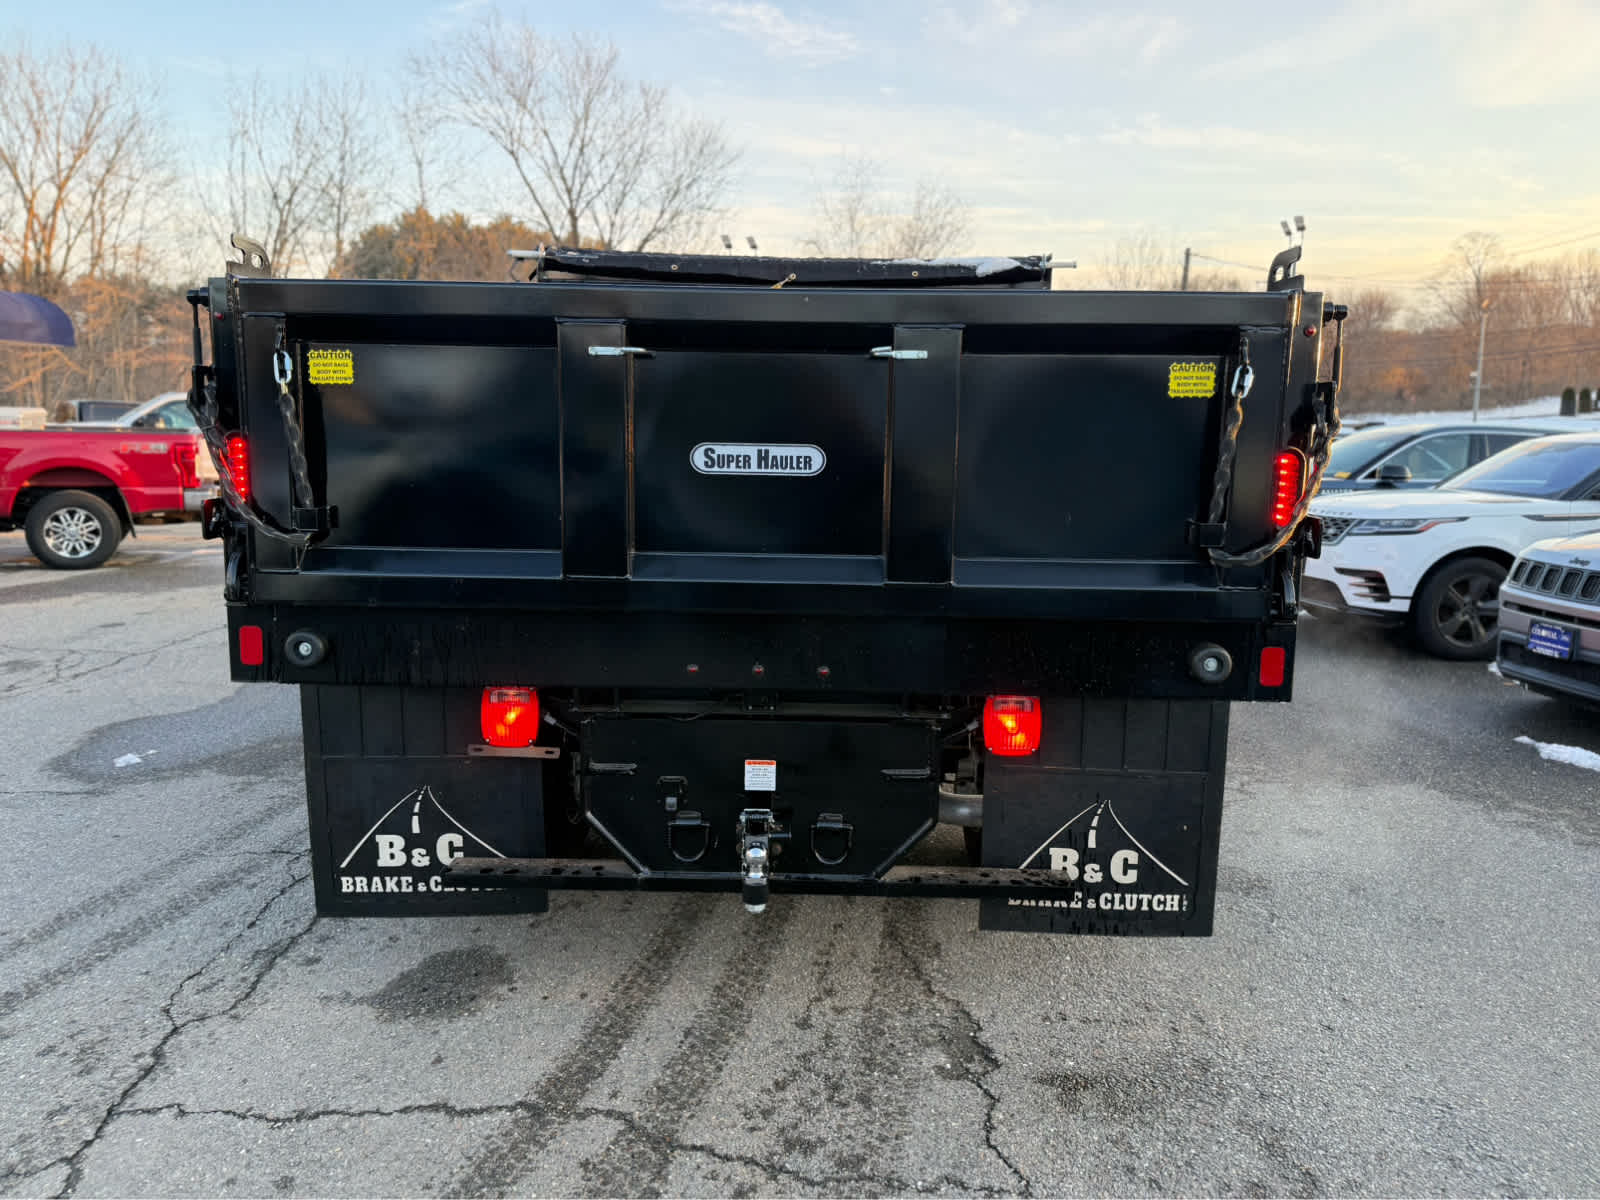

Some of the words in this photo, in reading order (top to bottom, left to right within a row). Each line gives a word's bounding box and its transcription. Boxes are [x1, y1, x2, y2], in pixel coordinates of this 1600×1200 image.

[309, 351, 351, 360] CAUTION
[1171, 364, 1214, 373] CAUTION
[340, 876, 413, 893] BRAKE
[1099, 892, 1179, 911] CLUTCH
